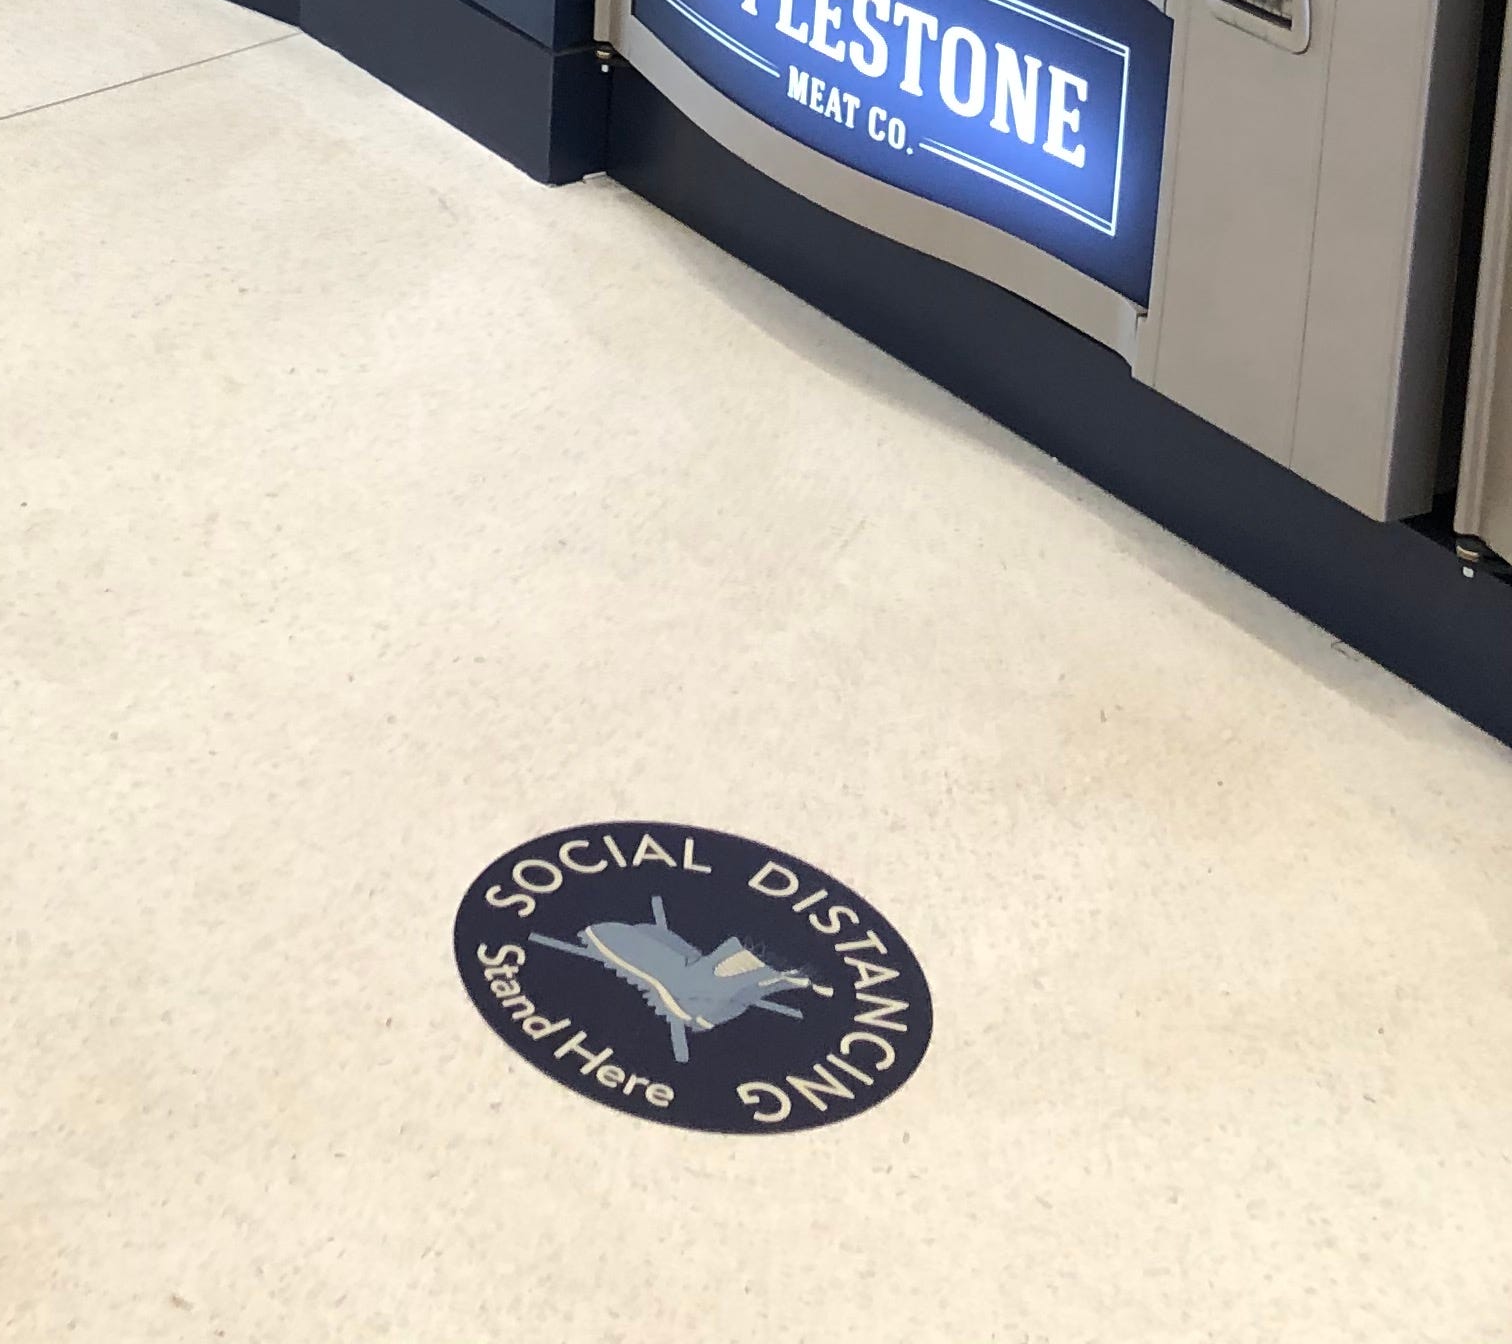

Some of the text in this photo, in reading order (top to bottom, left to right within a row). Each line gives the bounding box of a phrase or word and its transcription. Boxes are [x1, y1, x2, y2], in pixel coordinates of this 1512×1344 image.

[787, 66, 913, 155] MEAT CO.
[477, 942, 675, 1108] Stand Here
[485, 833, 910, 1123] SOCIAL DISTANCING
